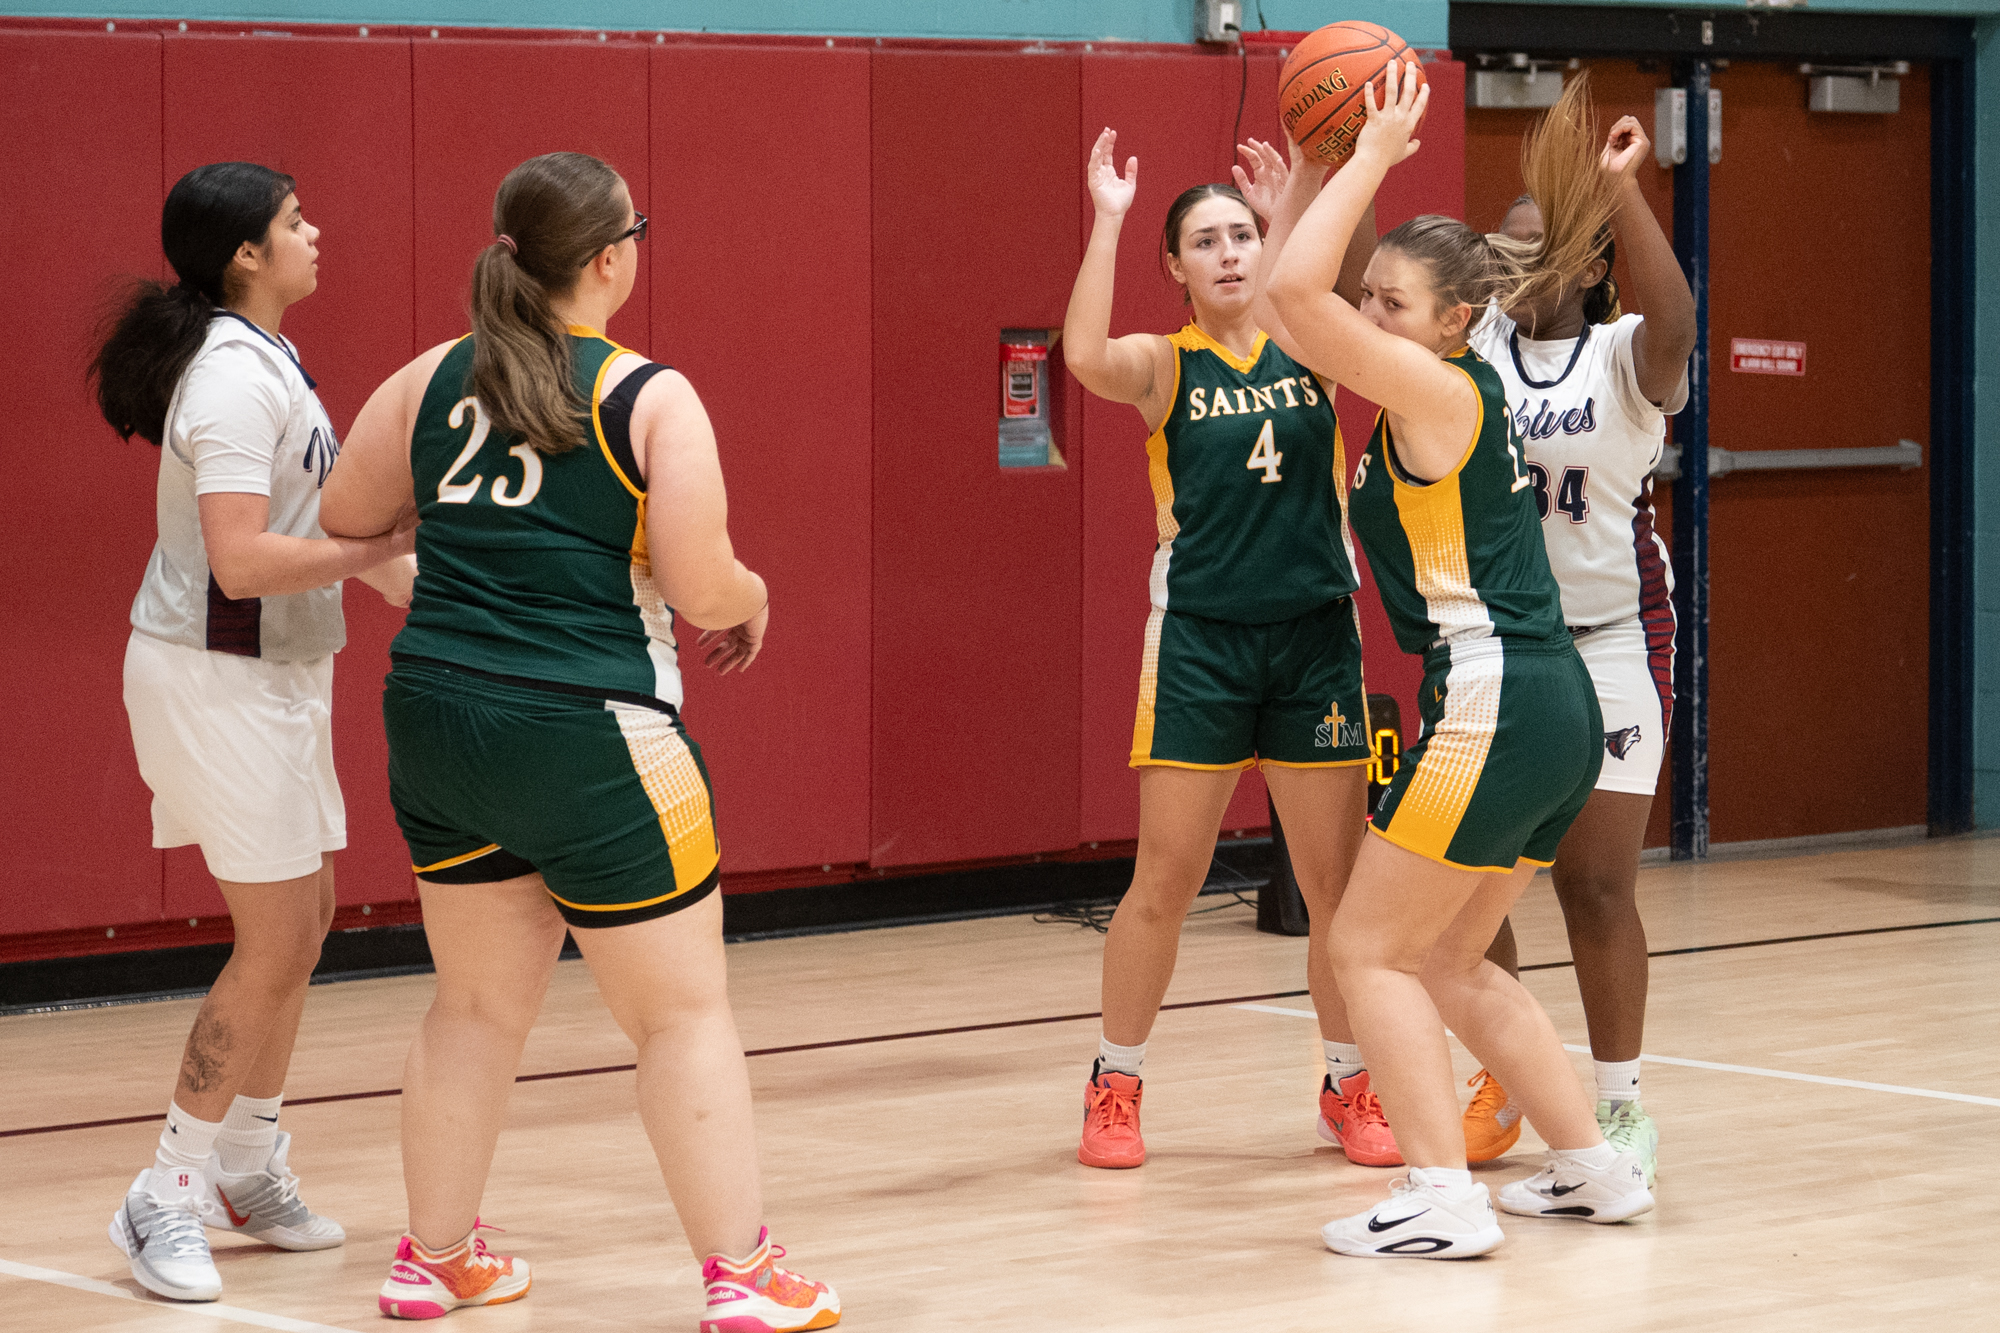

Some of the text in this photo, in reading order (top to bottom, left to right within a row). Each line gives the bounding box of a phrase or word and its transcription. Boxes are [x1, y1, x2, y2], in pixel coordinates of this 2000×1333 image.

[1316, 103, 1368, 158] EGACY
[1190, 375, 1319, 421] SAINTS
[1246, 419, 1284, 484] 4
